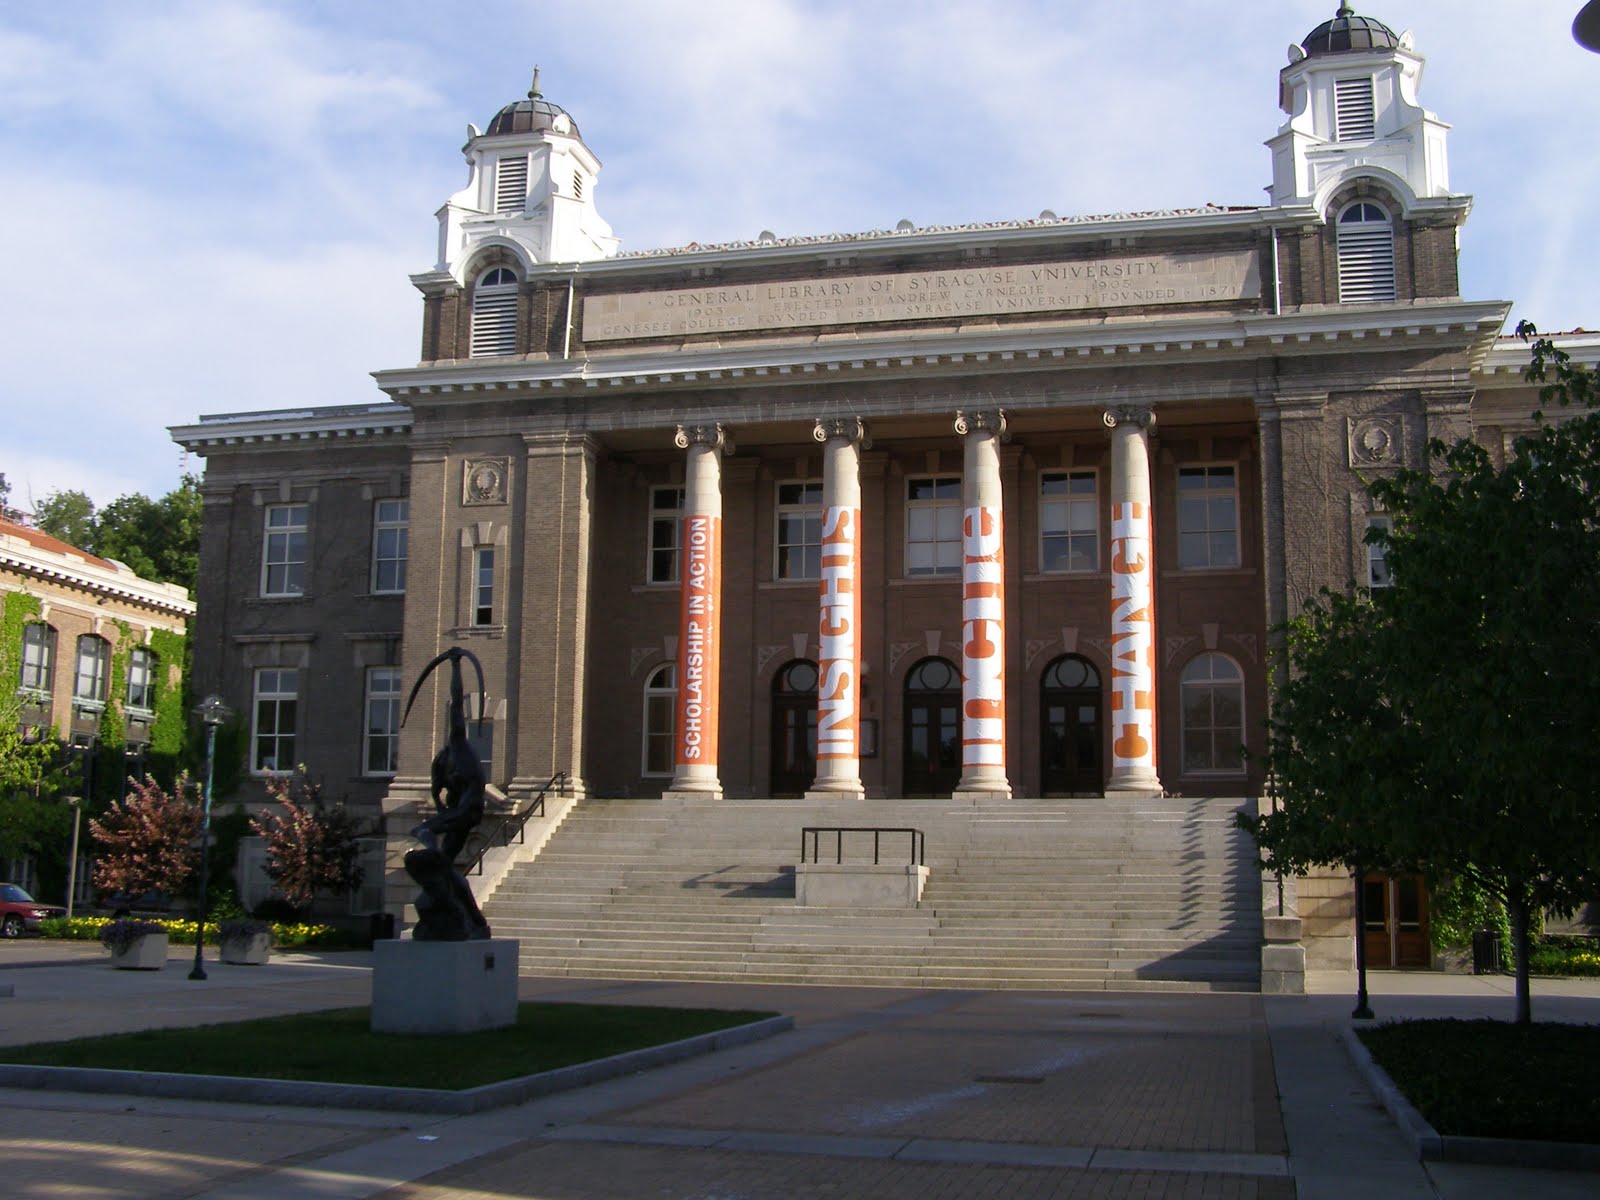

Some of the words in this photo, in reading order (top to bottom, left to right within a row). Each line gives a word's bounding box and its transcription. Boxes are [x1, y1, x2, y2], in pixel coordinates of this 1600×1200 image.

[604, 322, 670, 335] GENESEE
[680, 316, 746, 330] COLLEGE
[1200, 286, 1236, 297] 1871
[664, 289, 754, 307] GENERAL
[768, 282, 853, 300] LIBRARY
[870, 279, 894, 292] OF
[909, 271, 1015, 290] SYRACVSE
[1031, 262, 1160, 281] VNIVERSITY
[774, 298, 843, 312] ERECTED
[857, 295, 875, 306] BY
[888, 290, 951, 304] ANDREW
[965, 285, 1044, 299] CARNEGIE
[1092, 279, 1132, 290] 1905
[689, 518, 707, 589] ACTION
[688, 601, 705, 615] IN
[817, 506, 856, 755] INSIGHTS
[1111, 502, 1152, 768] CHANGE
[684, 620, 704, 760] SCHOLARSHIP
